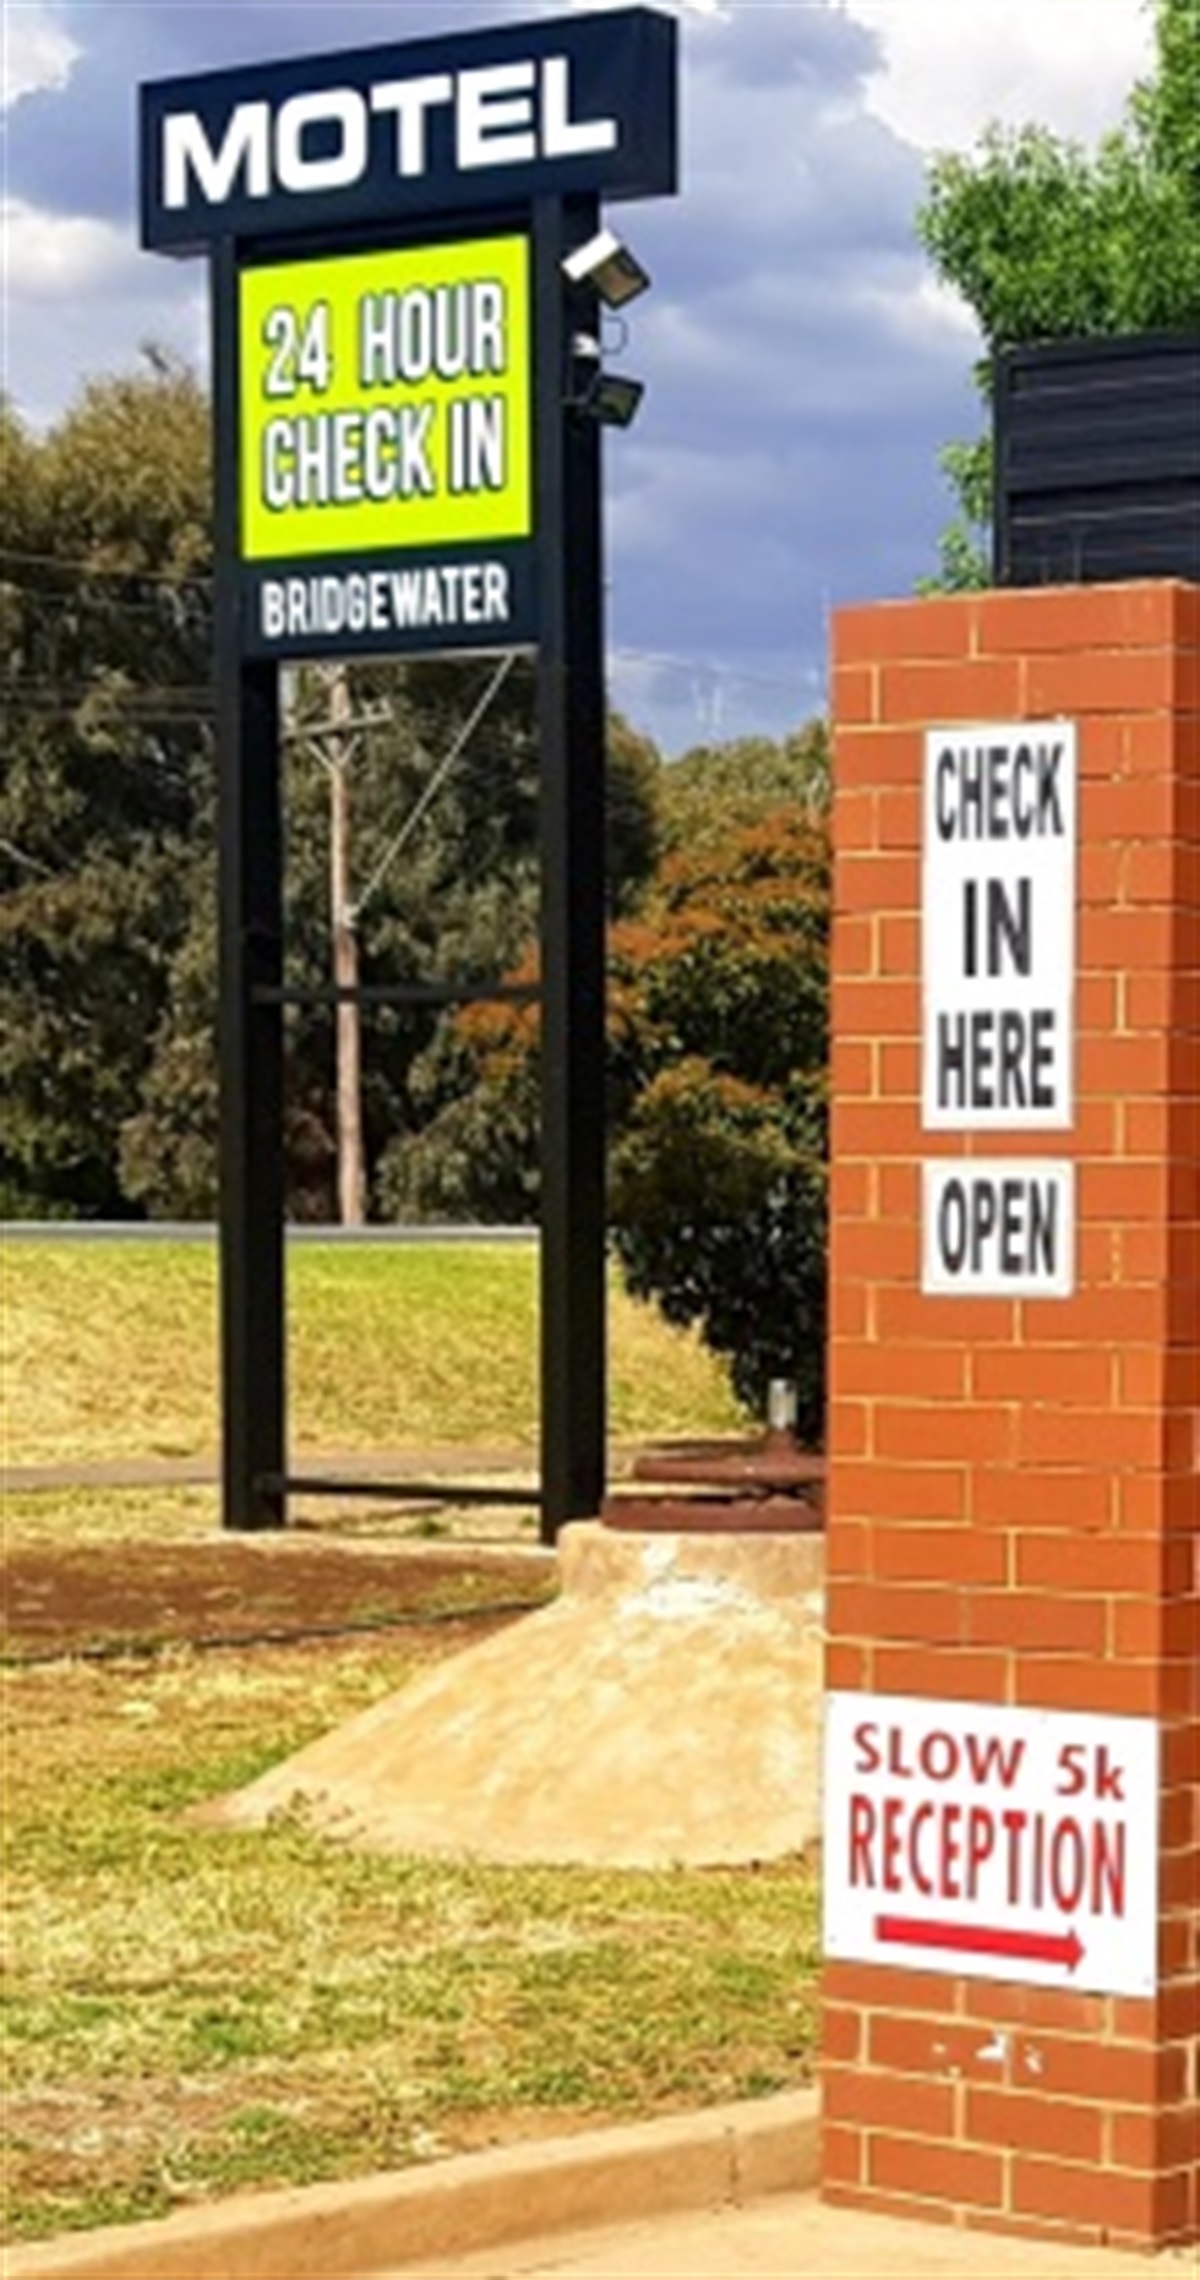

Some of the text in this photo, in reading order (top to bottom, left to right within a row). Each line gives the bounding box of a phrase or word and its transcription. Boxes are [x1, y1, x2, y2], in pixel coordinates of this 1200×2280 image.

[162, 56, 616, 209] MOTEL
[263, 282, 505, 396] 24 HOUR
[263, 398, 505, 509] CHECK IN
[262, 565, 508, 637] BRIDGEWATER
[936, 743, 1064, 841] CHECK
[963, 877, 1032, 977] IN
[937, 1009, 1055, 1109] HERE
[938, 1178, 1057, 1276] OPEN
[854, 1722, 1125, 1801] SLOW 5k
[850, 1793, 1125, 1918] RECEPTION
